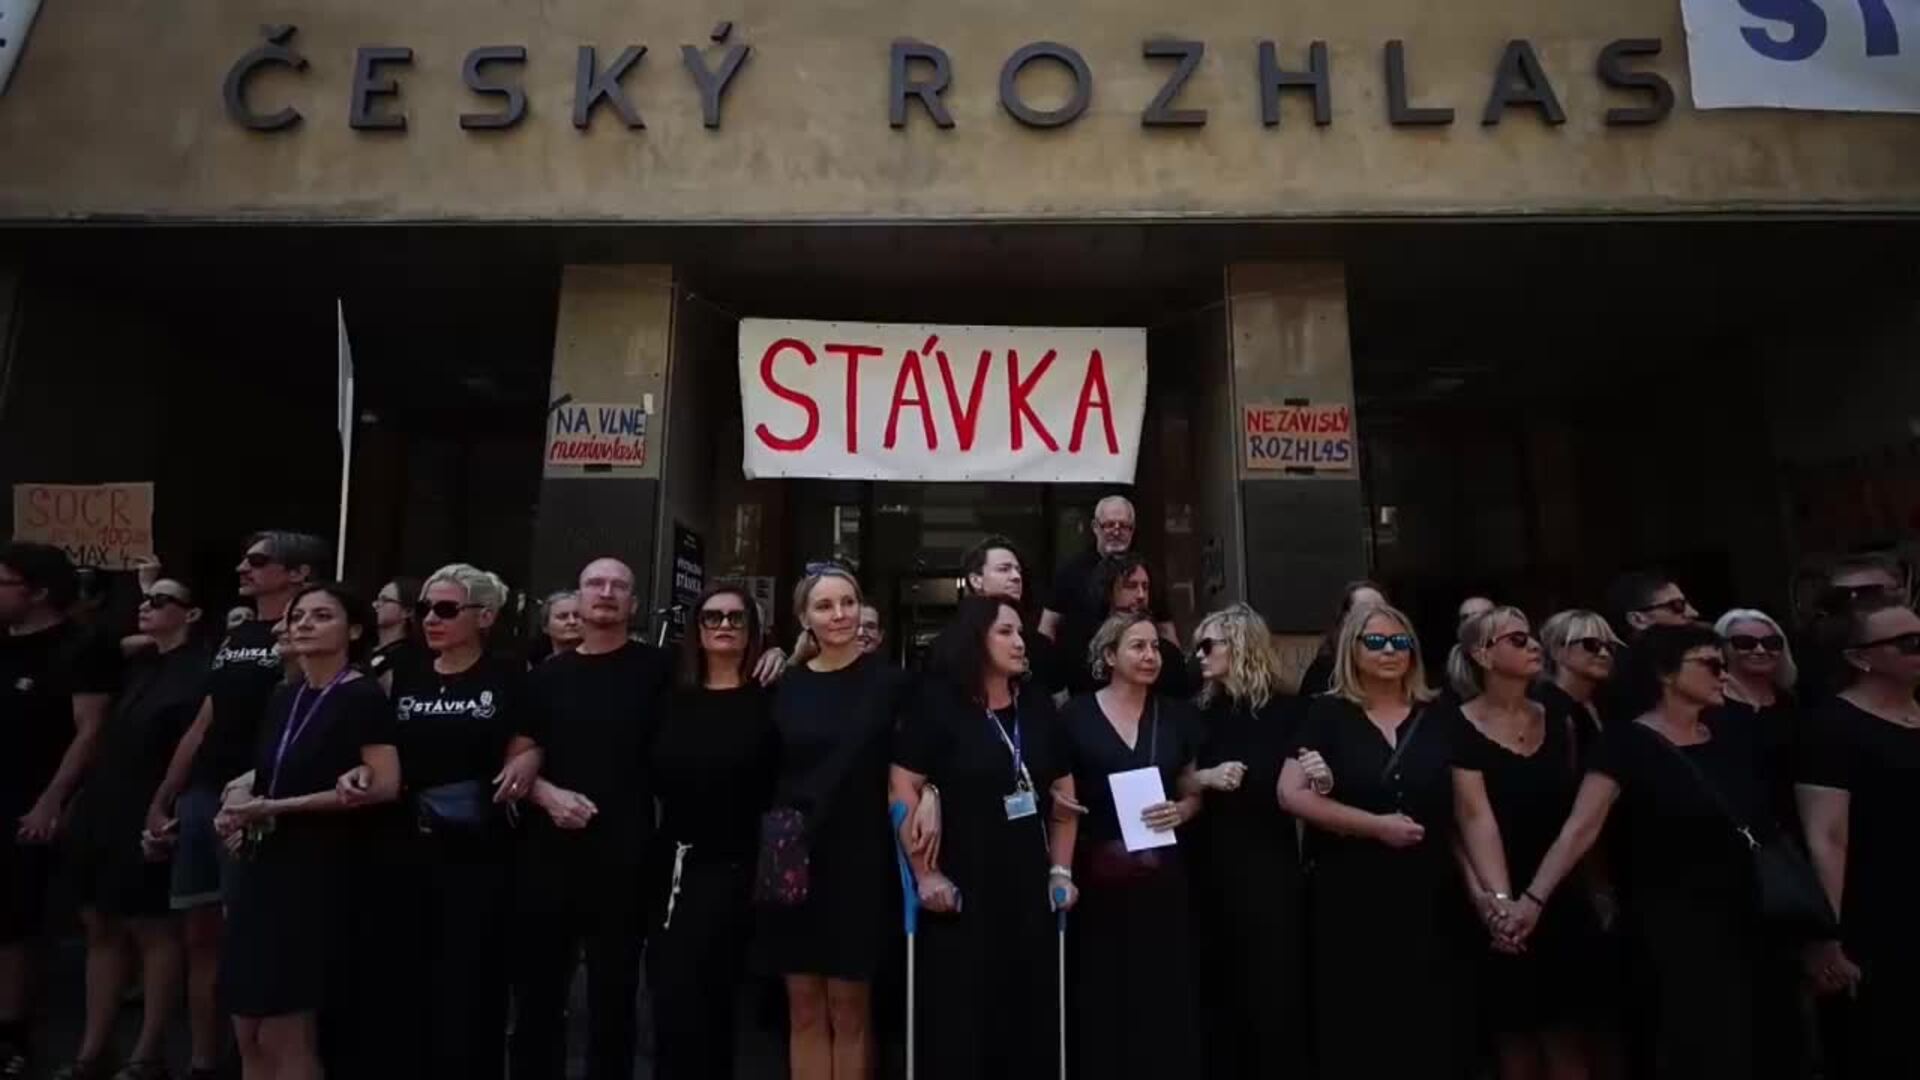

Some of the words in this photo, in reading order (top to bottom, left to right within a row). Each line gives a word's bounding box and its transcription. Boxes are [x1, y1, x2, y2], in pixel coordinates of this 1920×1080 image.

[223, 21, 749, 131] ČESKÝ
[889, 39, 1675, 127] ROZHLAS
[755, 334, 1119, 454] STÁVKA
[557, 407, 591, 434] NA
[1247, 406, 1349, 432] NEZÁVISLÝ
[1250, 435, 1349, 462] ROZHLAS
[414, 696, 478, 713] STÁVKA
